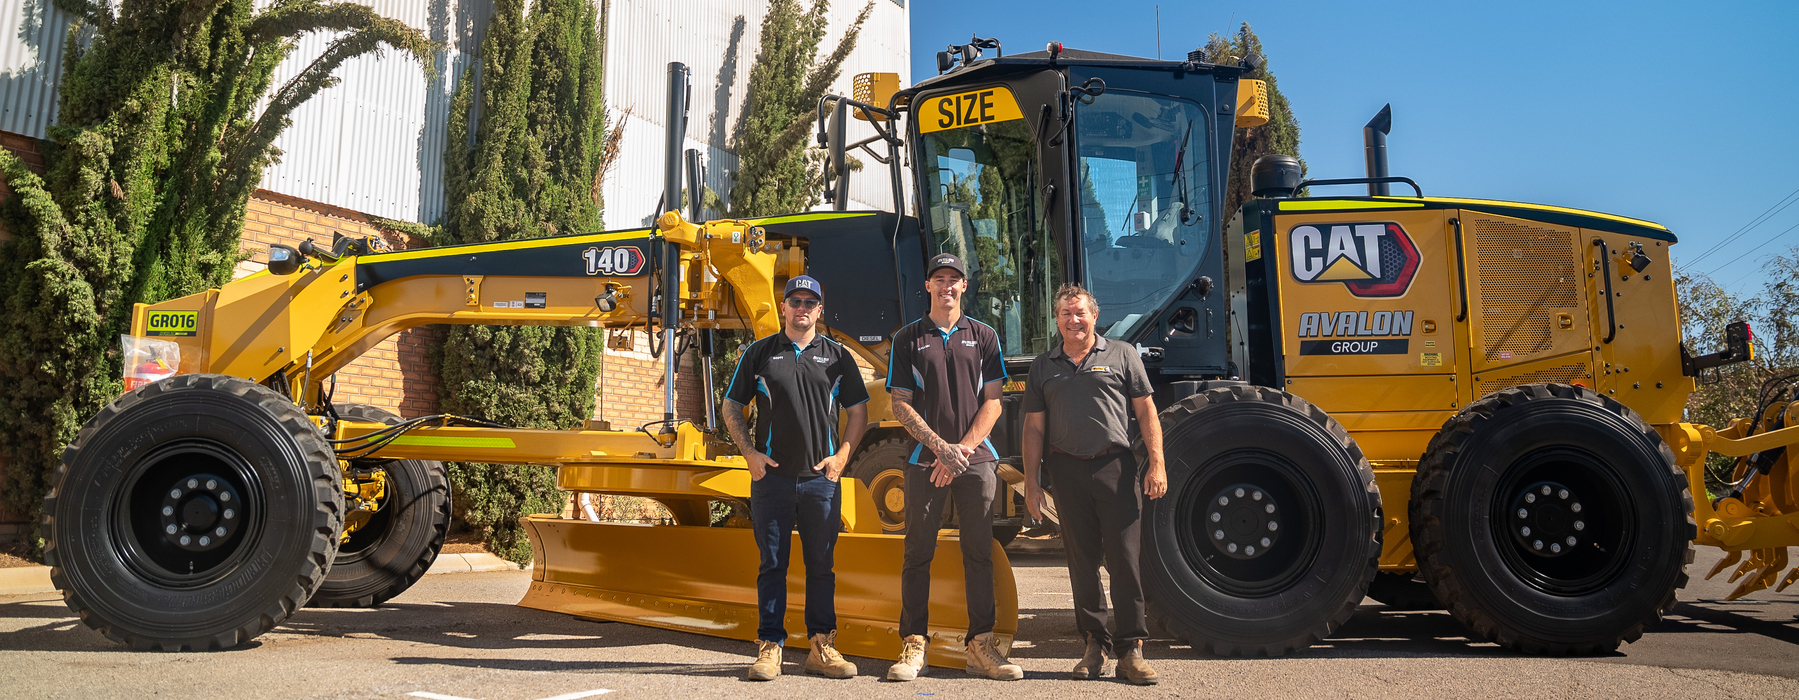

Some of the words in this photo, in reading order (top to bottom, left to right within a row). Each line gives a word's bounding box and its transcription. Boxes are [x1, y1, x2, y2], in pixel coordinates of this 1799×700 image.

[938, 90, 995, 129] SIZE
[584, 248, 630, 273] 140
[1291, 224, 1386, 281] CAT
[795, 279, 813, 289] CAT
[1298, 310, 1414, 338] AVALON
[1331, 341, 1379, 353] GROUP
